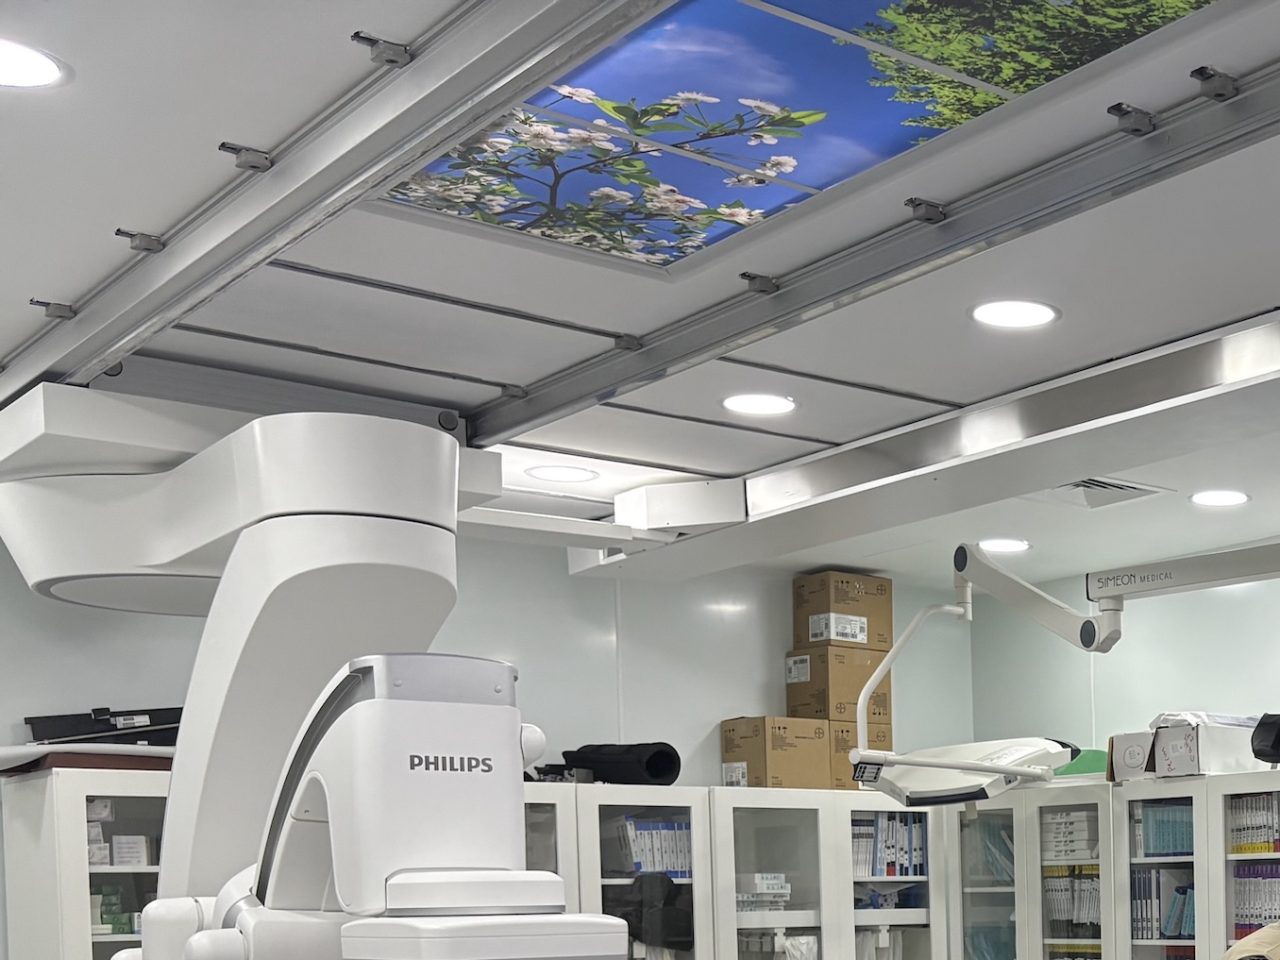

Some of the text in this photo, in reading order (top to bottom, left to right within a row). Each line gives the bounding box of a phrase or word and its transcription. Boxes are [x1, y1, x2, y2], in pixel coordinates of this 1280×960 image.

[1097, 572, 1173, 589] SIMEON MEDICAL
[409, 754, 493, 773] PHILIPS
